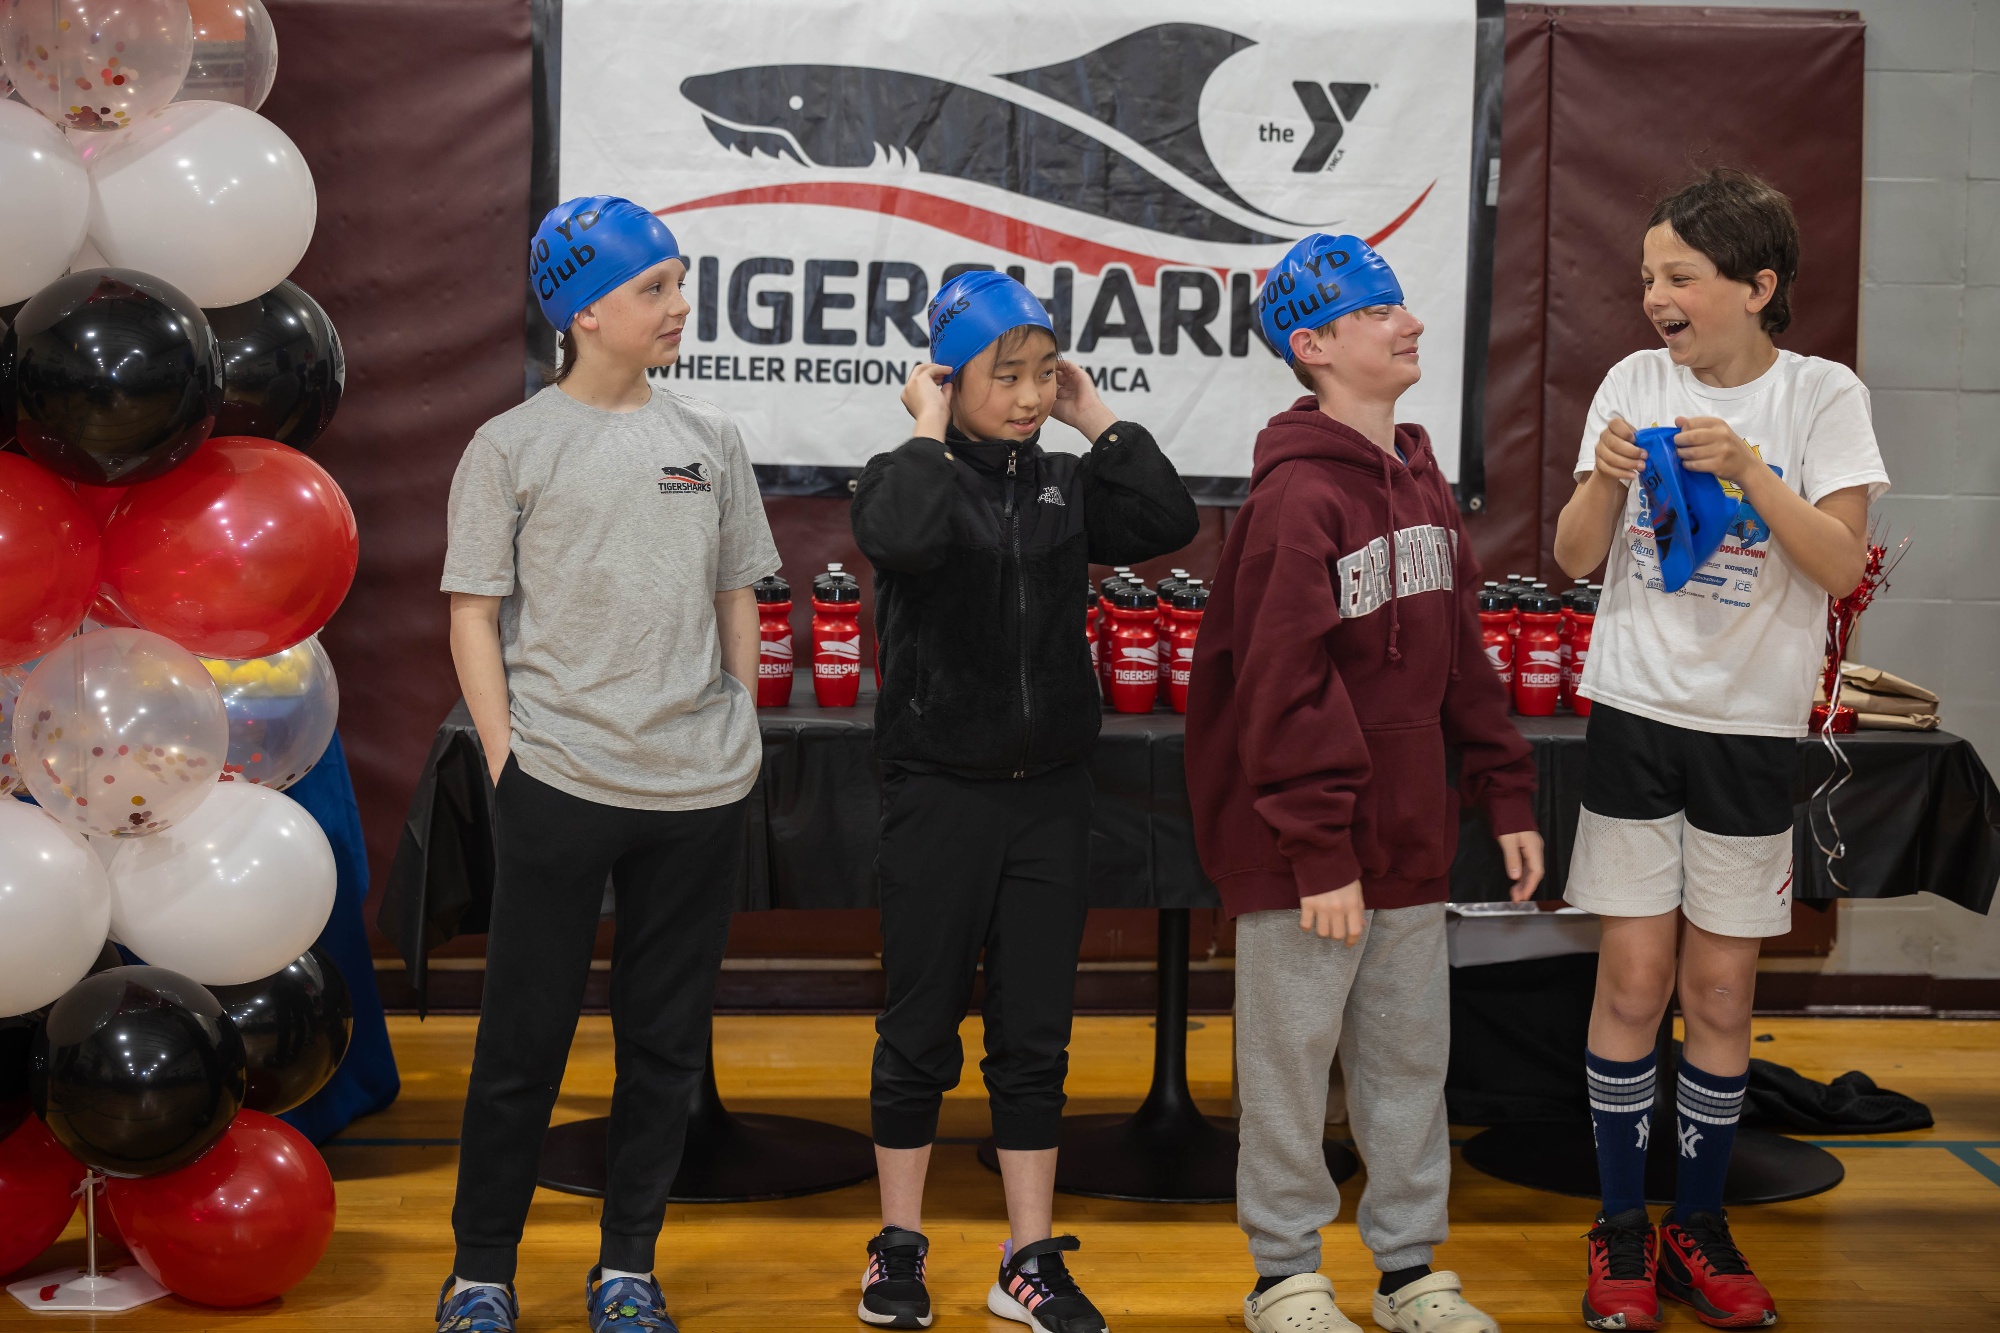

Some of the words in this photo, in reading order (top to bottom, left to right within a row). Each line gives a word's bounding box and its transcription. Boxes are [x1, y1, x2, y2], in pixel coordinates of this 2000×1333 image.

[1259, 122, 1294, 142] the
[1326, 149, 1345, 172] YMCA
[529, 238, 550, 276] 00
[554, 210, 600, 243] YD
[538, 244, 596, 300] Club
[1304, 250, 1350, 279] YD
[1273, 282, 1341, 331] Club
[795, 357, 919, 386] REGION
[1080, 366, 1151, 393] MCA
[658, 482, 711, 493] TIGERSHARKS
[1719, 598, 1751, 608] PEPSICO
